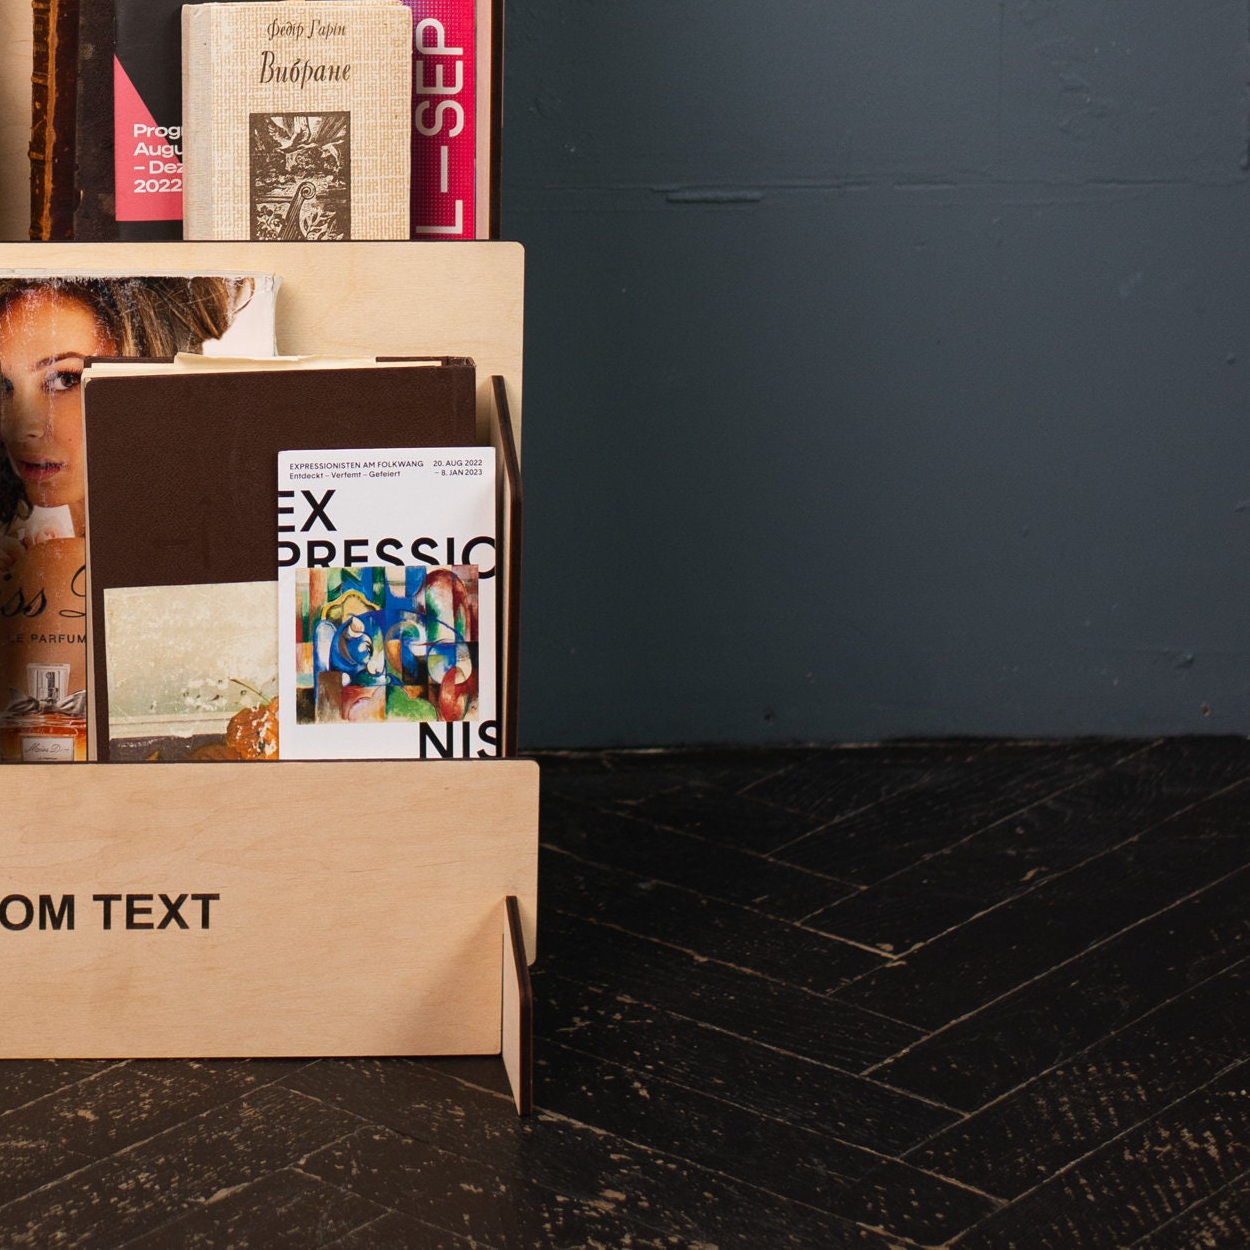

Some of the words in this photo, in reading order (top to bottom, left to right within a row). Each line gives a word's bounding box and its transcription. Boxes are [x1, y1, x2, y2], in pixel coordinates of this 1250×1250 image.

[259, 50, 351, 89] Вибране
[415, 18, 464, 137] SEP
[134, 124, 182, 139] Prog
[134, 179, 182, 193] 2022
[290, 462, 360, 470] EXPRESSIONISTEN
[290, 472, 323, 480] Entdeckt
[332, 471, 361, 479] Verfemt
[369, 470, 400, 478] Gefeiert
[278, 489, 337, 532] EX
[30, 634, 86, 643] PARFUM
[93, 893, 220, 930] TEXT
